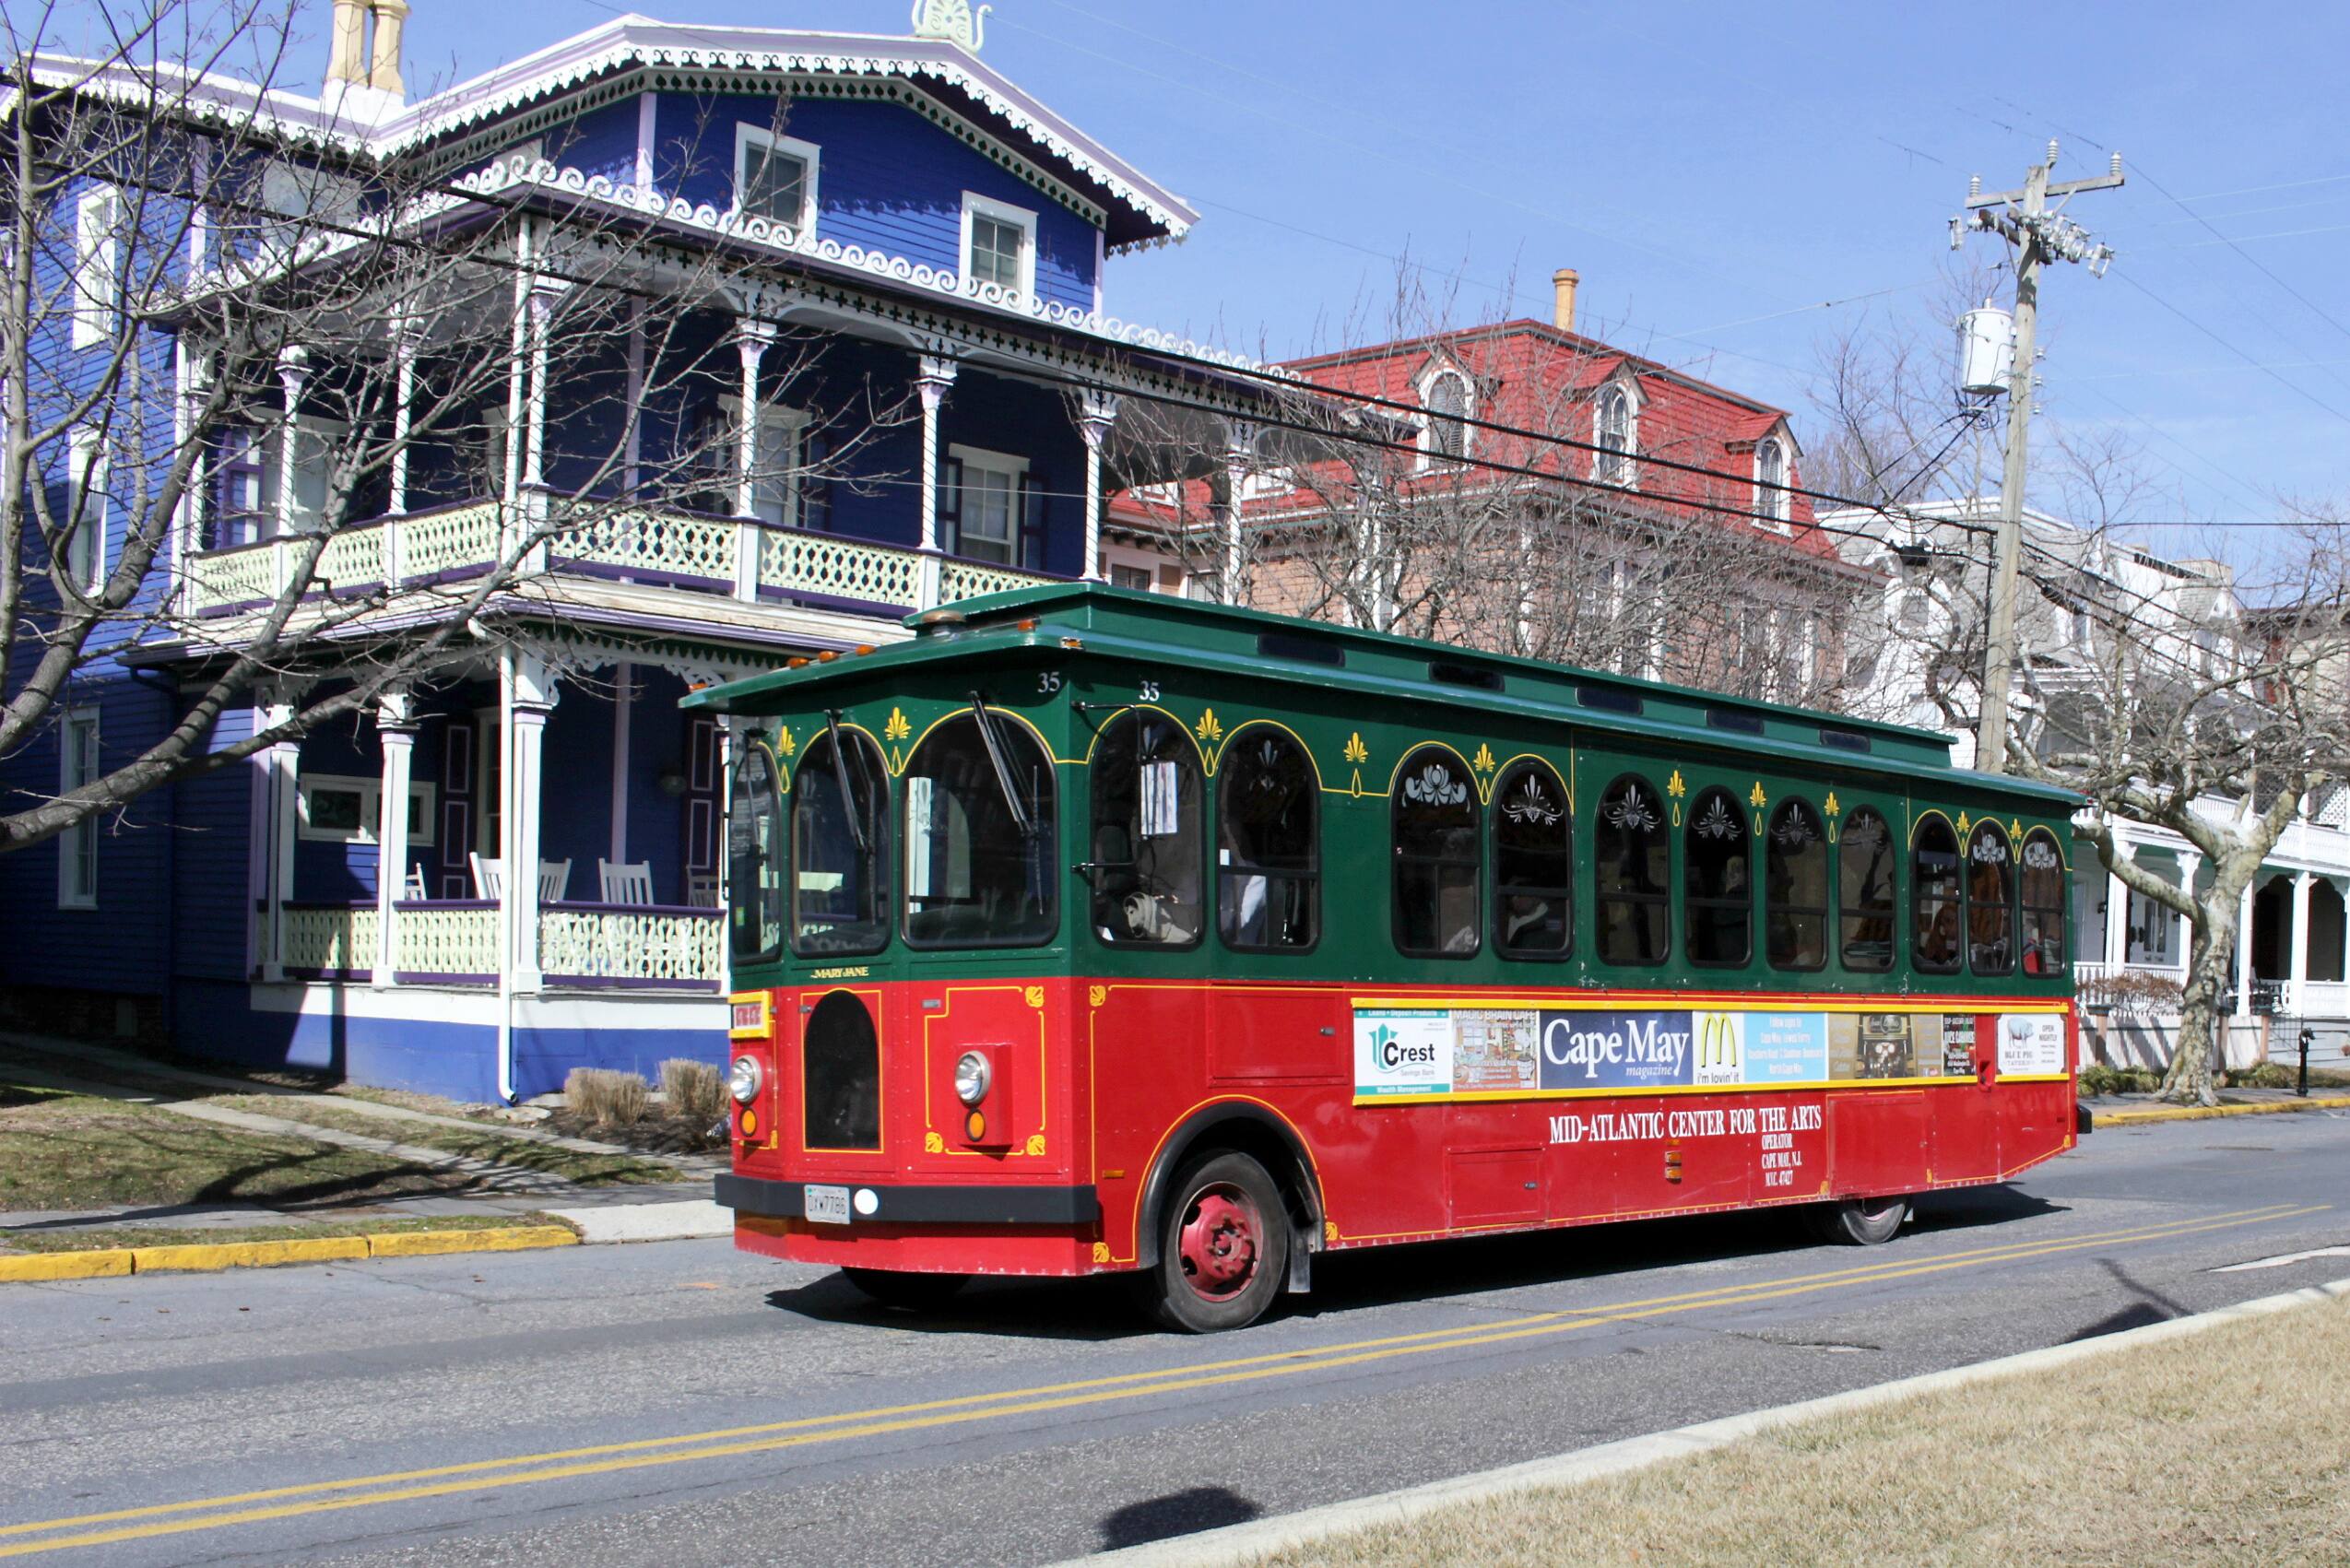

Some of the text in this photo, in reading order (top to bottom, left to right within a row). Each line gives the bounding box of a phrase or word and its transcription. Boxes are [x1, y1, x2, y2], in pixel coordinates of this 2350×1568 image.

[1037, 671, 1060, 693] 35
[1139, 680, 1160, 702] 35
[810, 966, 869, 979] MARY JANE
[1383, 1041, 1435, 1067] Crest
[1544, 1018, 1689, 1079] Cape May
[2023, 1051, 2033, 1059] PIG
[1625, 1064, 1673, 1080] magazine
[1697, 1072, 1709, 1084] i'm
[1734, 1071, 1740, 1083] it
[1549, 1104, 1822, 1146] MID-ATLANTIC CENTER FOR THE ARTS
[1762, 1133, 1793, 1150] OPERATOR
[1762, 1153, 1777, 1170] CAPE
[1792, 1150, 1802, 1166] N.J.
